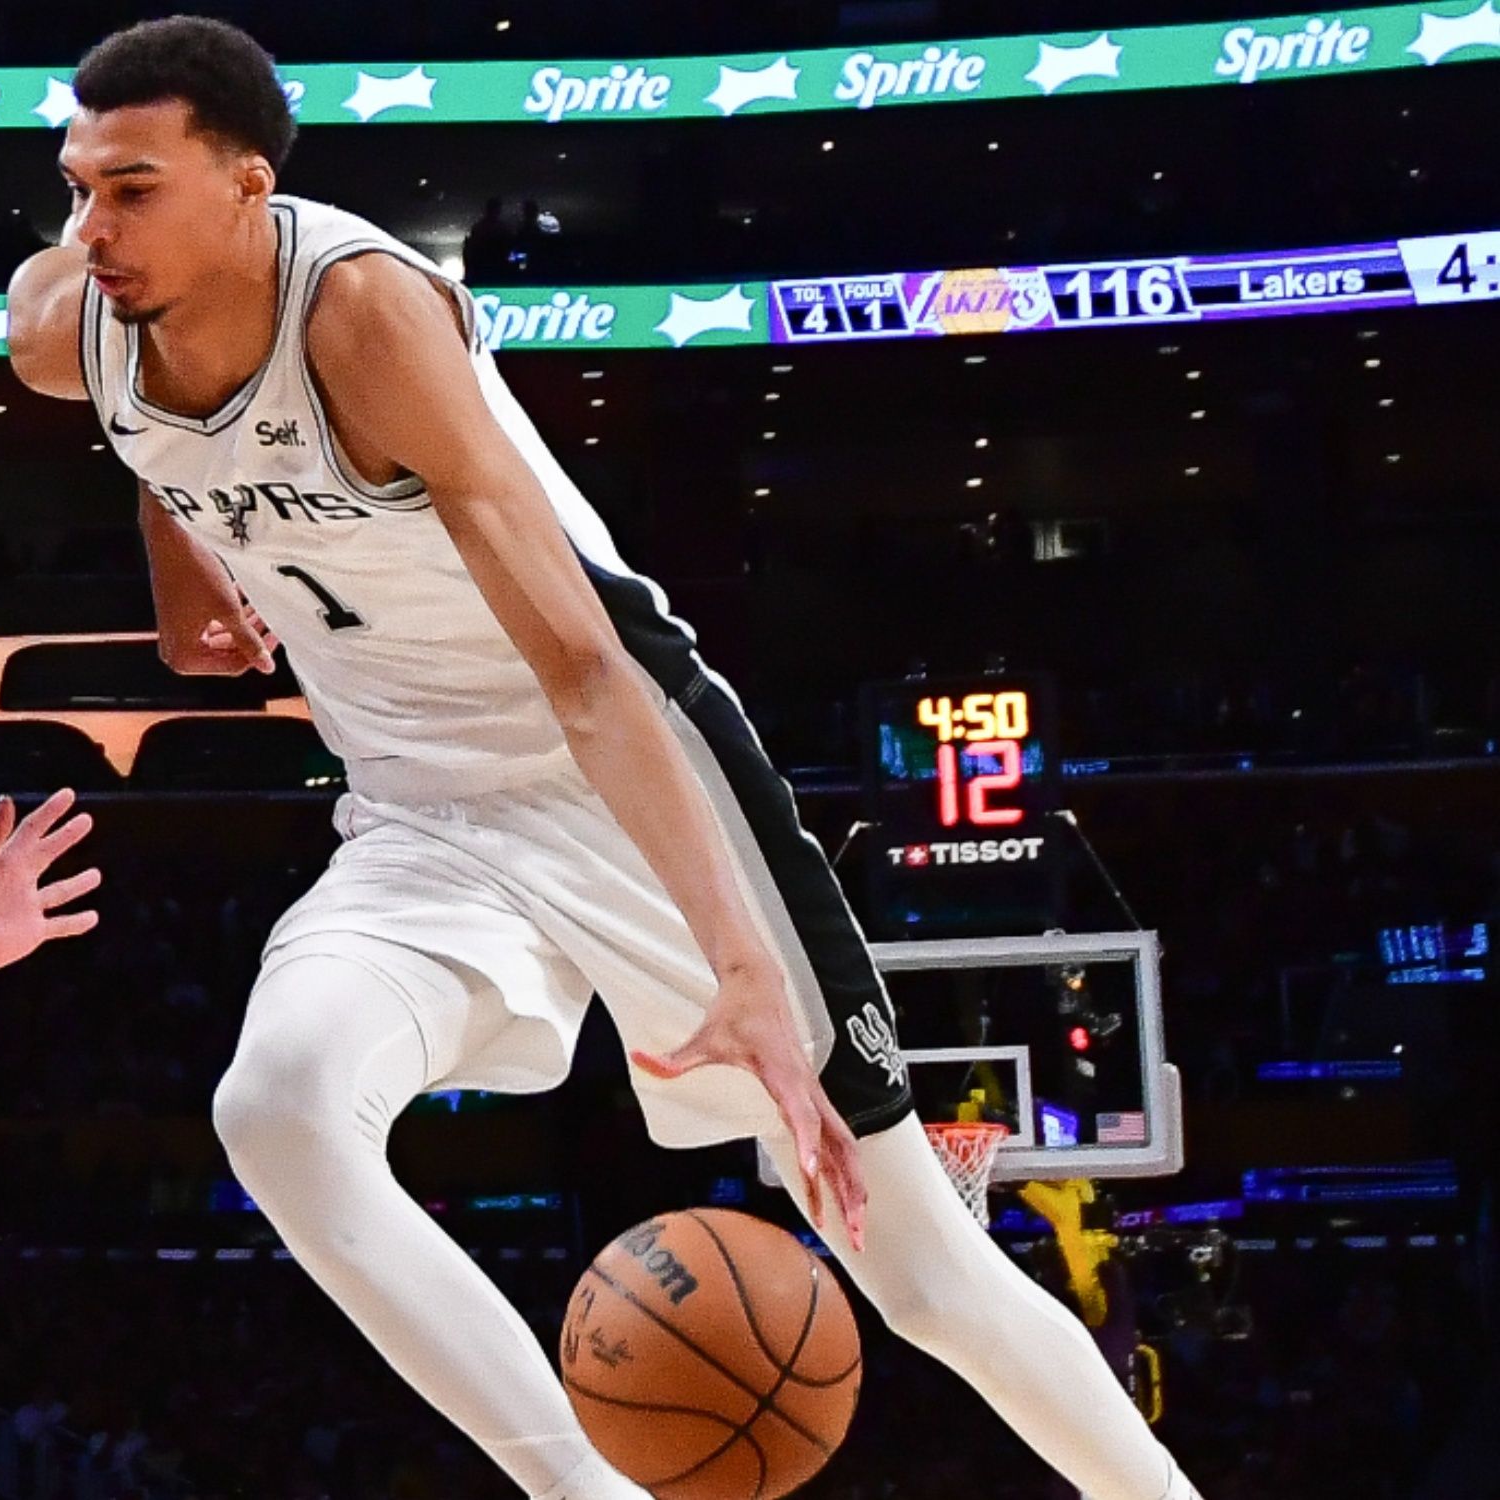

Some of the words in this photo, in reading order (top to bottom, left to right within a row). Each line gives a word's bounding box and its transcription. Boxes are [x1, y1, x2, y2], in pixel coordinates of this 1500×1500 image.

[523, 65, 671, 122] Sprite
[835, 47, 986, 108] Sprite
[1215, 19, 1370, 84] Sprite
[792, 287, 826, 303] TOL
[844, 281, 894, 300] FOULS
[803, 303, 829, 333] 4
[864, 302, 883, 331] 1
[1065, 266, 1176, 318] 116
[1239, 267, 1365, 301] Lakers
[473, 291, 616, 351] Sprite
[272, 563, 371, 630] 1
[917, 691, 1029, 742] 4:50
[937, 739, 1024, 827] 12
[930, 837, 1044, 865] TISSOT
